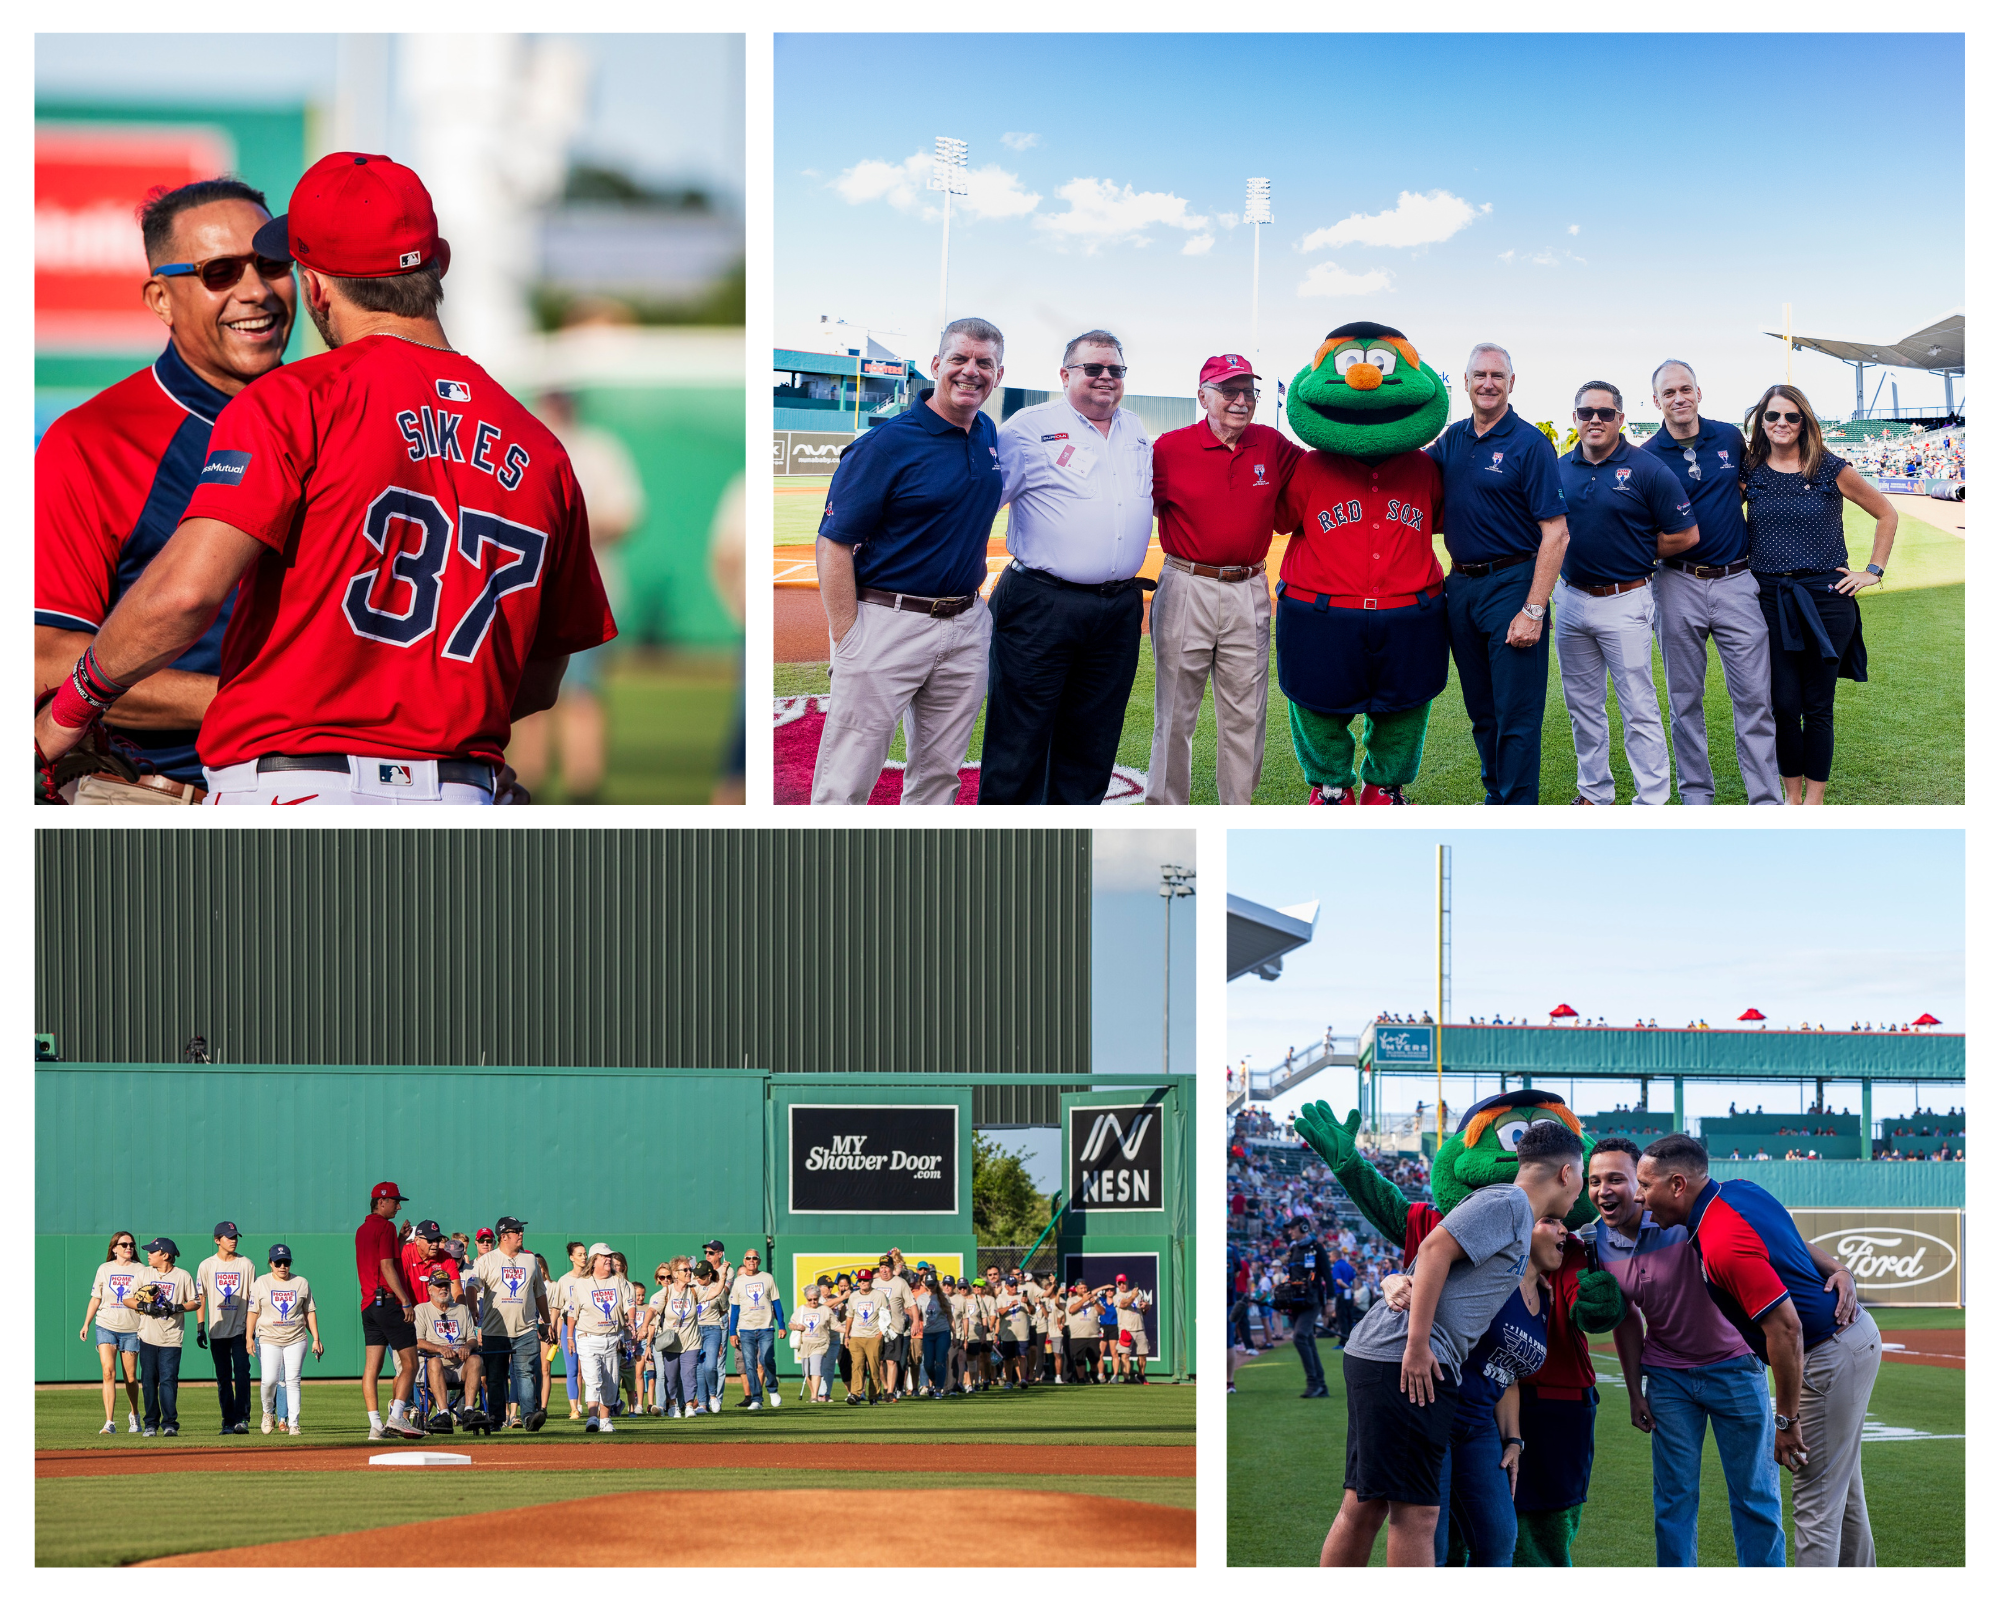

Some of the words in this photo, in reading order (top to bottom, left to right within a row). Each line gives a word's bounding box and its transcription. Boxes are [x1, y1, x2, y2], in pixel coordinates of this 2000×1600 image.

[396, 405, 531, 491] SIKES
[1317, 499, 1363, 534] RED
[1386, 499, 1424, 532] SOX
[341, 485, 549, 664] 37
[805, 1146, 888, 1171] Shower
[889, 1150, 943, 1170] Door
[831, 1135, 868, 1155] MY
[913, 1170, 942, 1179] .com
[1082, 1169, 1150, 1203] NESN
[1837, 1235, 1927, 1278] Ford
[1488, 1346, 1536, 1379] FORC
[1512, 1339, 1546, 1371] AIR
[1533, 1339, 1547, 1356] PROU
